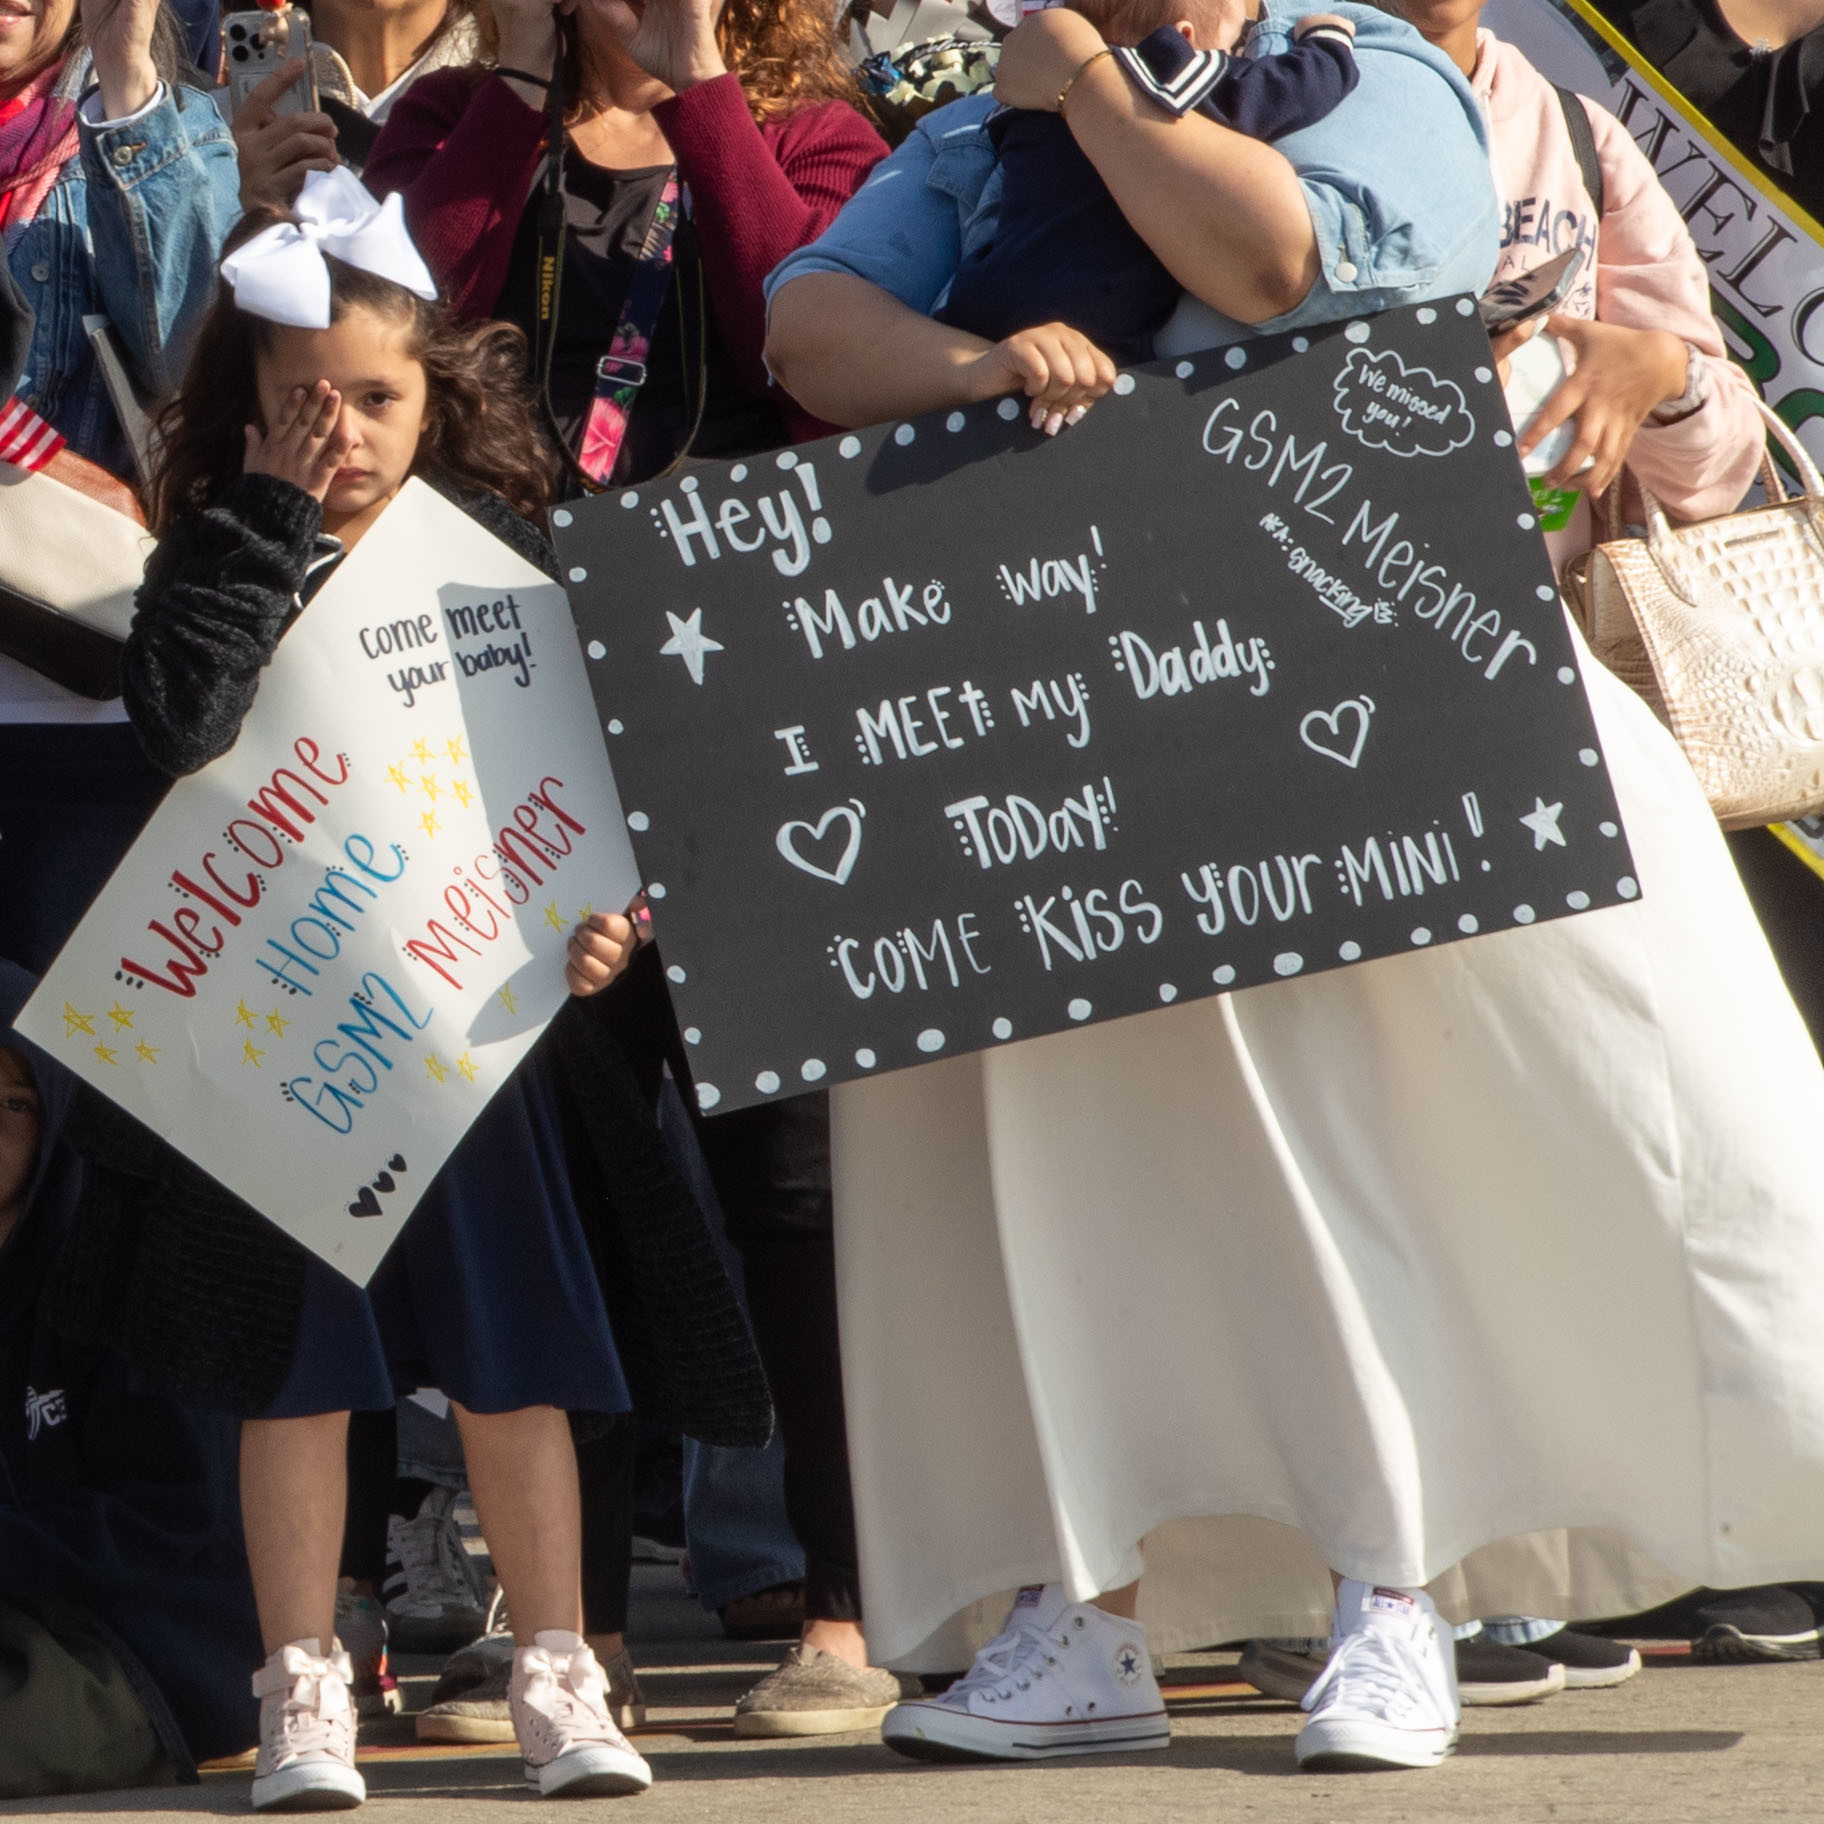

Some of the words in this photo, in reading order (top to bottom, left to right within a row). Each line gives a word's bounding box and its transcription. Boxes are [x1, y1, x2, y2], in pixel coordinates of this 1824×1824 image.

[541, 256, 555, 320] Nikon
[1357, 363, 1387, 393] We
[1385, 383, 1452, 425] missed
[1361, 401, 1412, 437] you!
[659, 462, 833, 576] Hey!
[1200, 396, 1353, 524] GSM2
[1342, 497, 1537, 680] Meisner
[445, 593, 522, 640] meet
[794, 577, 951, 659] Make
[999, 524, 1109, 614] way!
[387, 660, 451, 708] your
[455, 631, 538, 688] baby!
[774, 724, 819, 776] I
[1119, 618, 1270, 700] Daddy
[120, 735, 349, 999] Welcome
[255, 832, 405, 997] Home
[289, 971, 434, 1135] GSM2
[404, 776, 587, 991] Meisner
